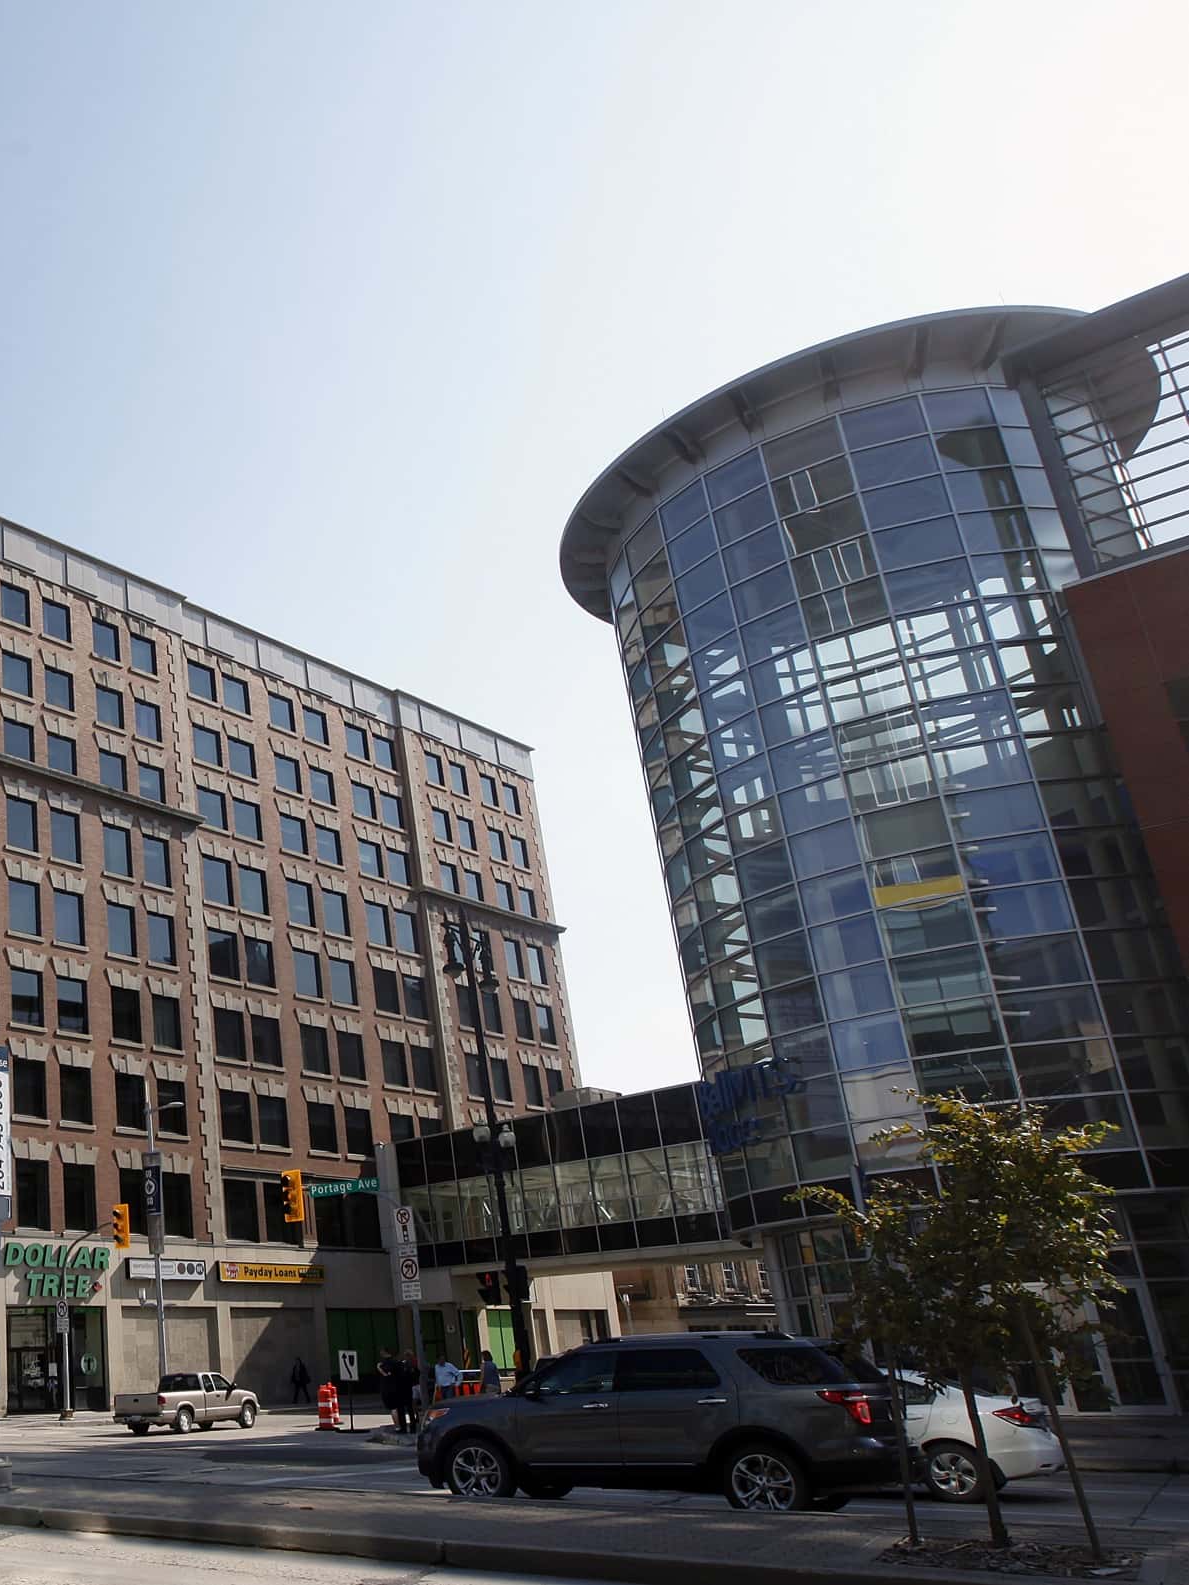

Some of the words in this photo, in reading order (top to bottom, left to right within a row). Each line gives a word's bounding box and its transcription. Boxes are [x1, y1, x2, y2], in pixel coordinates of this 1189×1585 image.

[311, 1182, 353, 1195] Portage
[358, 1179, 378, 1189] Ave
[5, 1242, 110, 1270] DOLLAR
[244, 1265, 272, 1278] Payday
[274, 1267, 296, 1277] Loans
[25, 1271, 92, 1298] TREE
